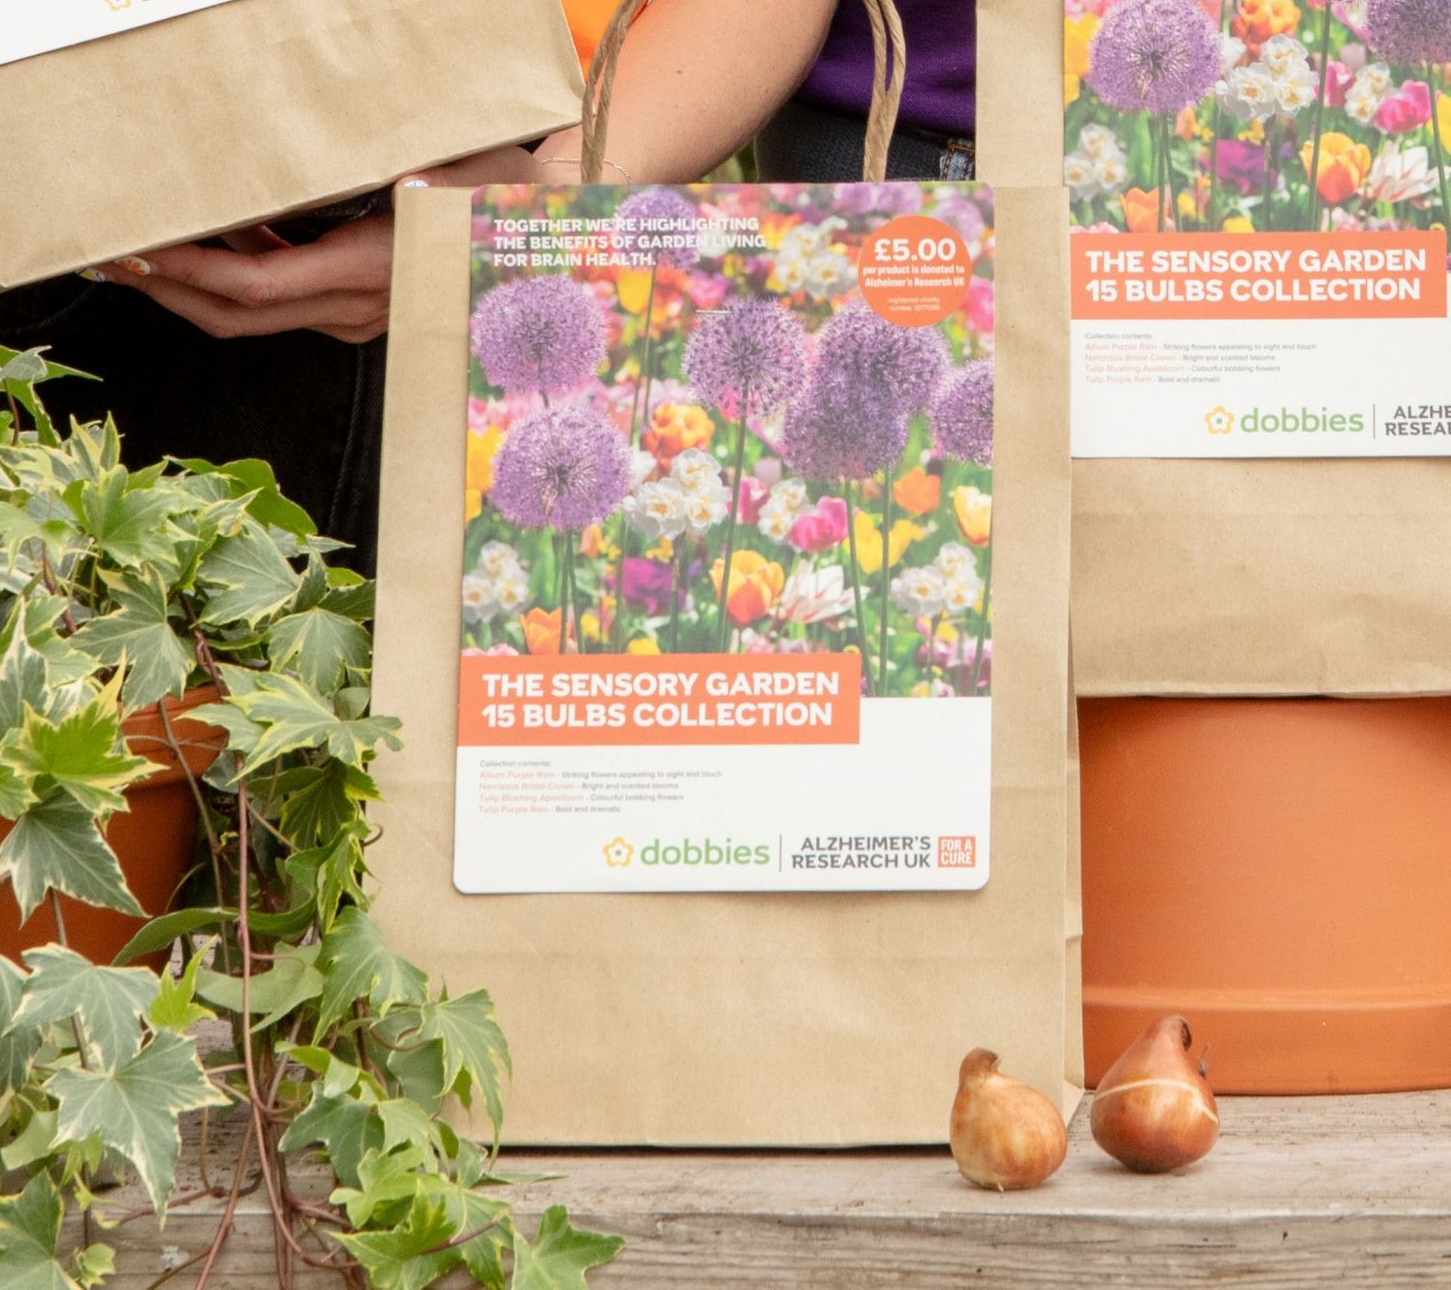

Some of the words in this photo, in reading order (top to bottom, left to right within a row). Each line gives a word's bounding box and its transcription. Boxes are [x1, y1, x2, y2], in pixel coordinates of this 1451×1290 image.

[494, 219, 581, 232] TOGETHER
[585, 219, 636, 231] WE'RE
[640, 218, 758, 231] HIGHLIGHTING
[493, 236, 526, 249] THE
[529, 236, 608, 249] BENEFITS
[612, 236, 632, 248] OF
[637, 236, 709, 248] GARDEN
[713, 235, 765, 248] LIVING
[874, 237, 955, 261] £5.00
[493, 253, 528, 266] FOR
[531, 253, 581, 266] BRAIN
[586, 253, 655, 266] HEALTH.
[1085, 250, 1143, 273] THE
[1151, 249, 1291, 273] SENSORY
[1299, 248, 1425, 272] GARDEN
[1085, 279, 1118, 302] 15
[1125, 279, 1223, 302] BULBS
[1230, 277, 1420, 301] COLLECTION
[1240, 406, 1364, 433] dobbies
[482, 673, 543, 697] THE
[551, 672, 698, 697] SENSORY
[706, 671, 838, 696] GARDEN
[481, 704, 515, 728] 15
[523, 703, 626, 727] BULBS
[633, 702, 832, 727] COLLECTION
[640, 838, 770, 865] dobbies
[801, 836, 930, 851] ALZHEIMER'S
[941, 839, 961, 850] FOR
[963, 839, 972, 850] A
[792, 853, 900, 868] RESEARCH
[904, 853, 930, 868] UK
[941, 851, 973, 864] CURE
